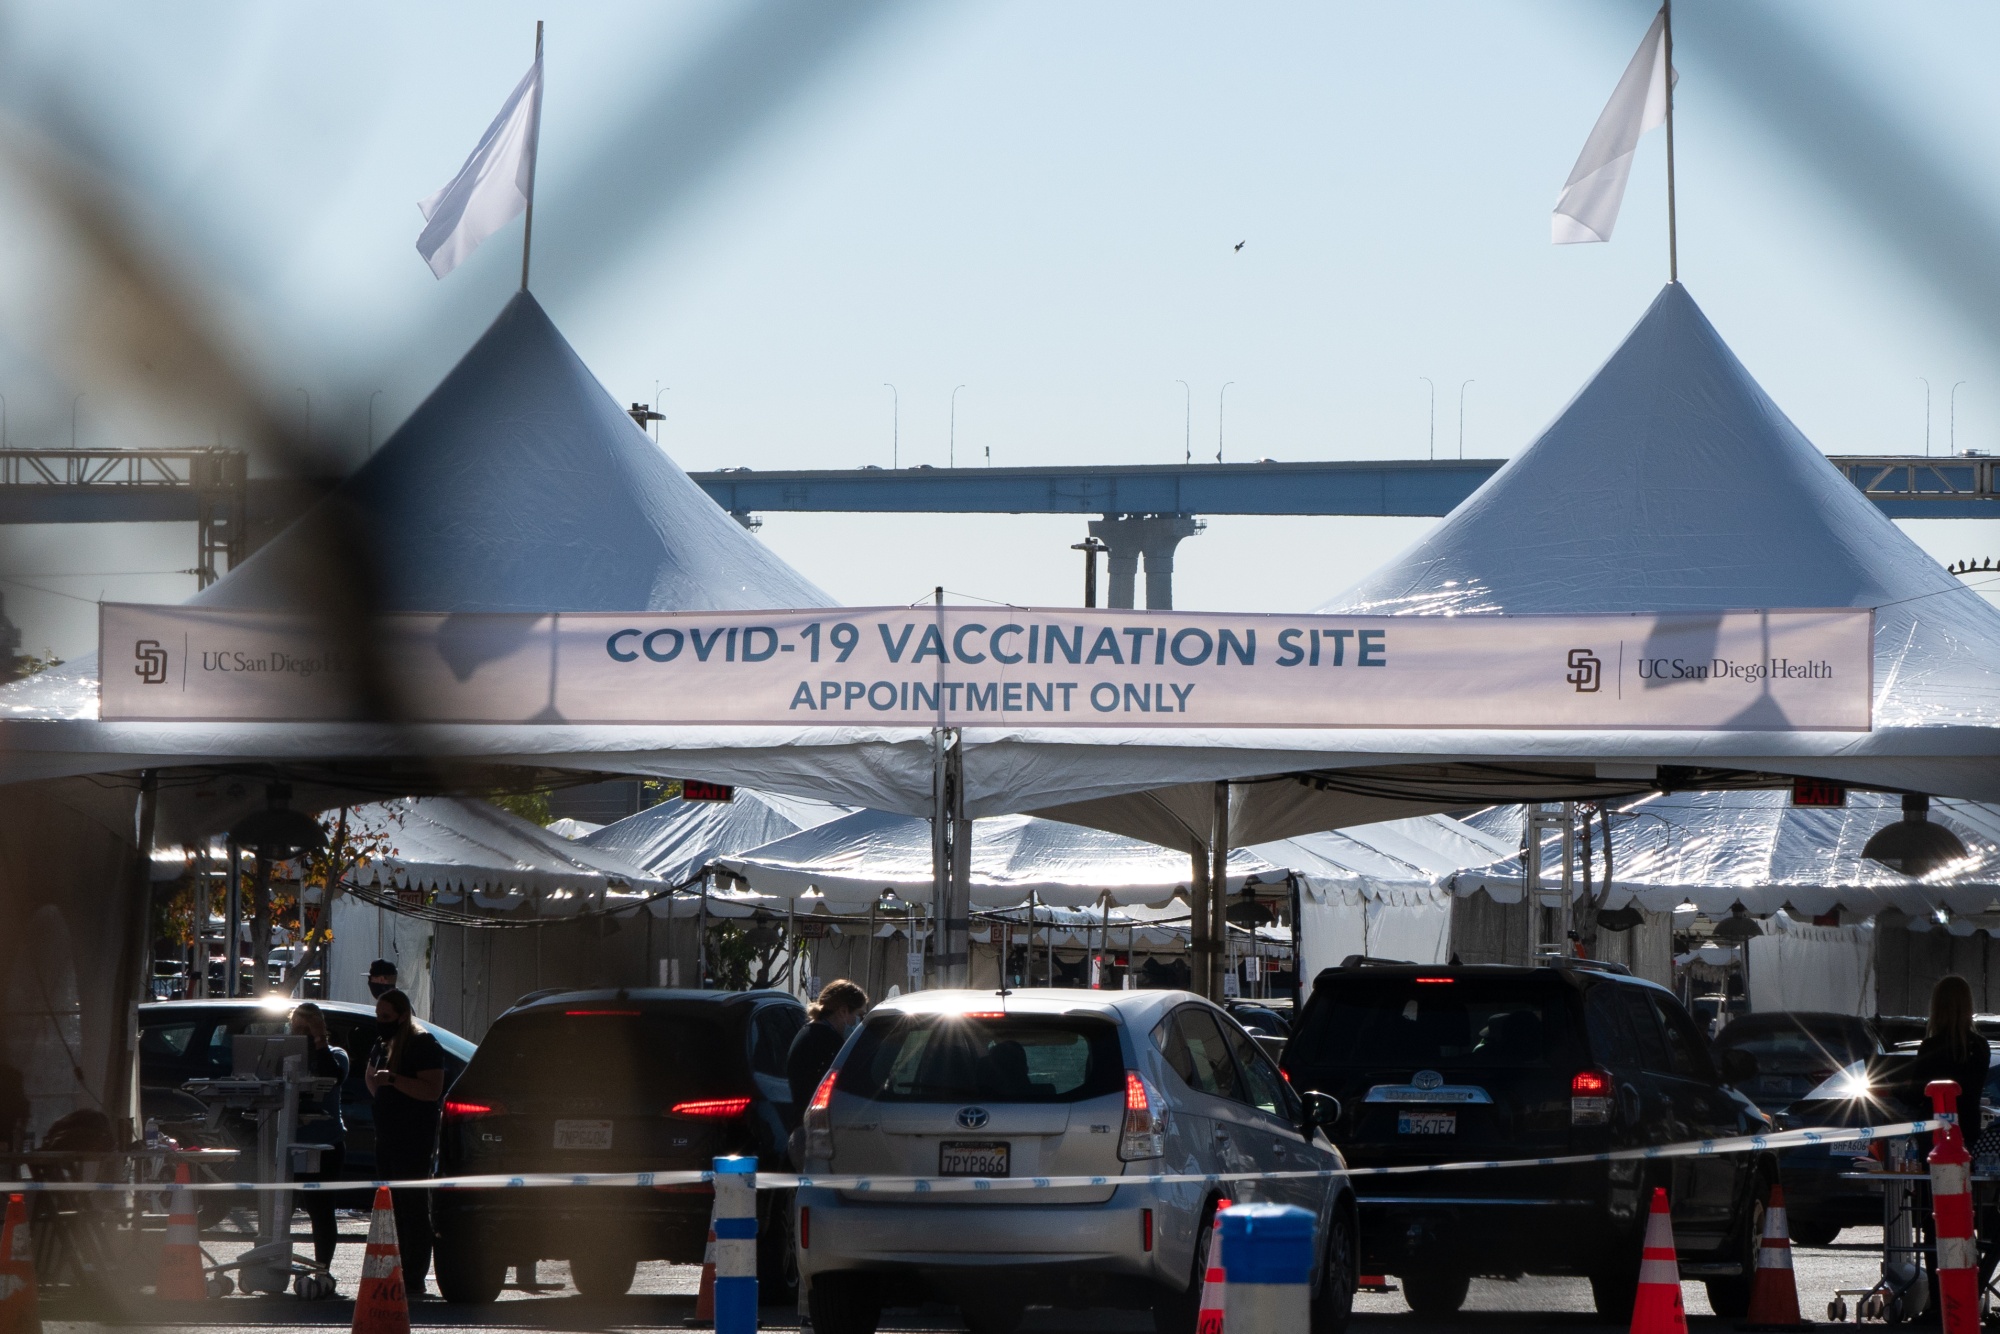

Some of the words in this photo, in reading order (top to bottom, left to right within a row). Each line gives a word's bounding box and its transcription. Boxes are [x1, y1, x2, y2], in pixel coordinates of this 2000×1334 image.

[606, 622, 859, 663] COVID-19
[877, 623, 1256, 666] VACCINATION
[1275, 627, 1387, 667] SITE
[203, 651, 231, 672] UC
[234, 651, 267, 672] San
[271, 652, 322, 677] Diego
[1638, 658, 1668, 680] UC
[1671, 658, 1708, 680] San
[1712, 658, 1767, 683] Diego
[1770, 657, 1833, 680] Health
[789, 681, 1078, 712] APPOINTMENT
[1090, 681, 1196, 713] ONLY
[944, 1155, 1004, 1172] 7PYP866
